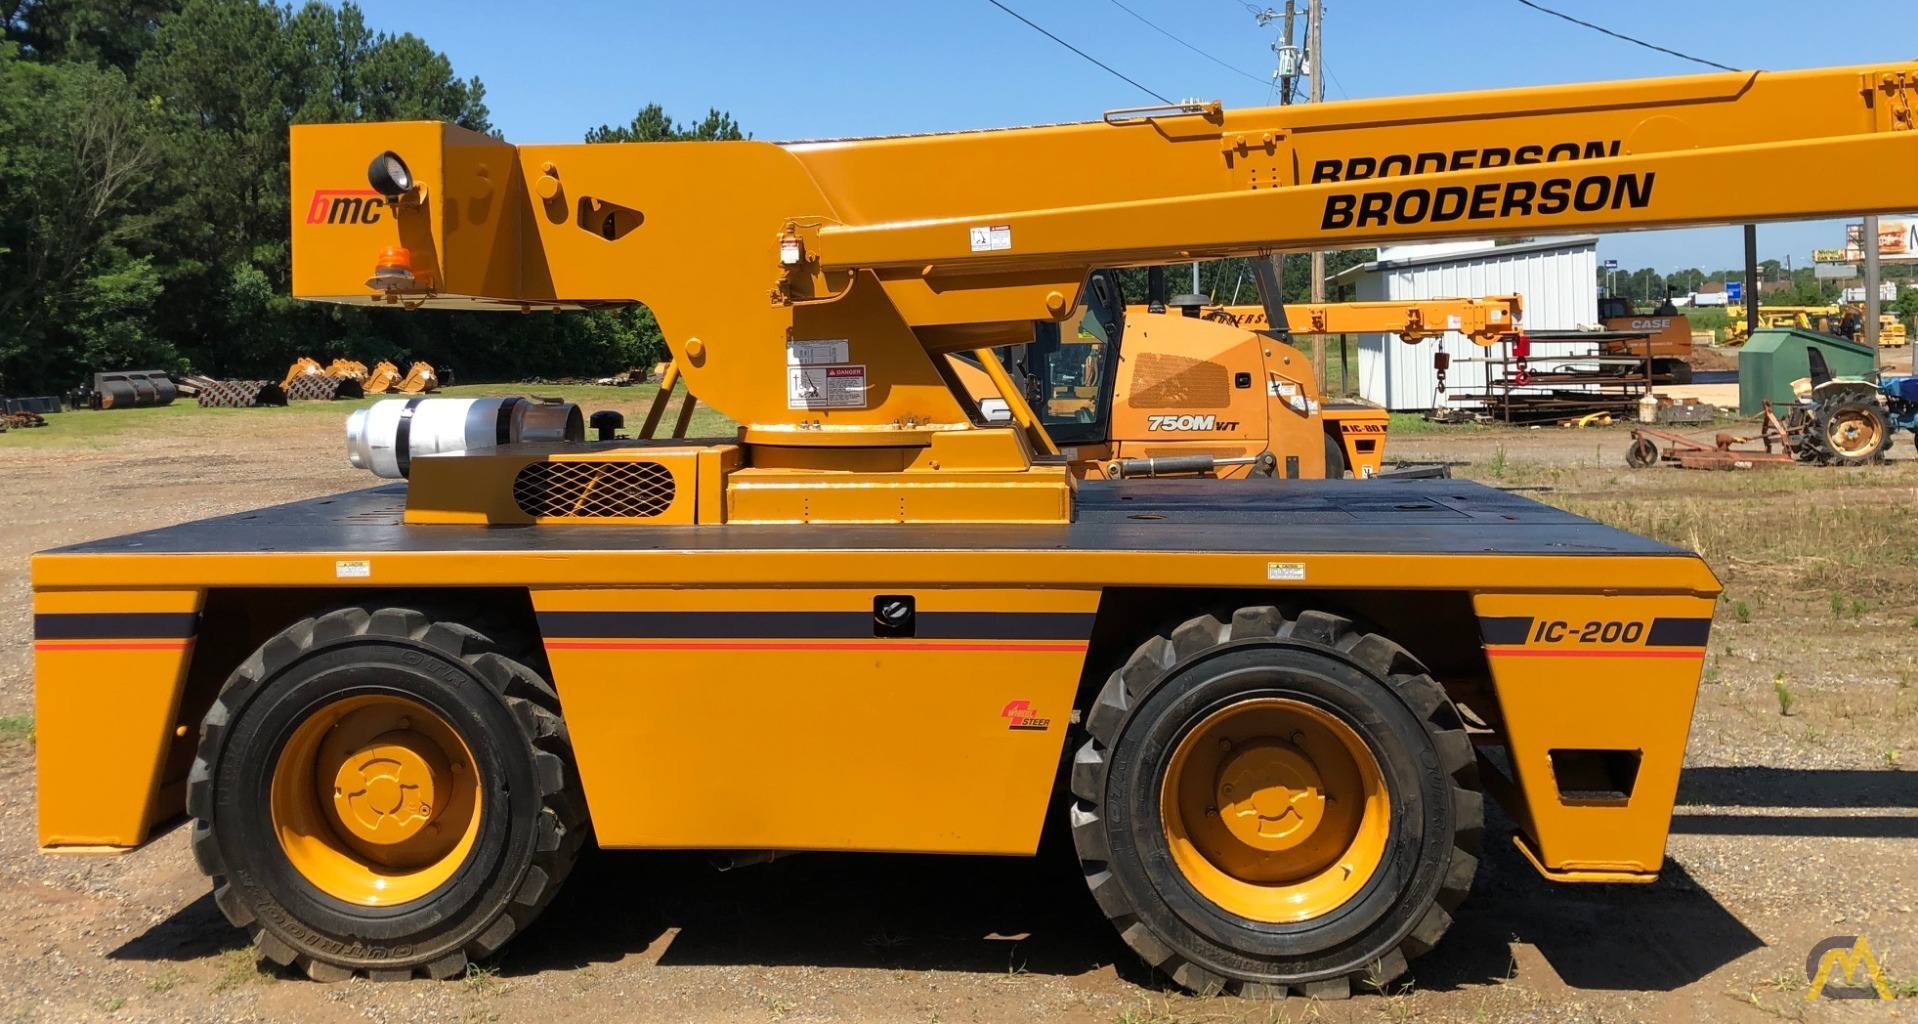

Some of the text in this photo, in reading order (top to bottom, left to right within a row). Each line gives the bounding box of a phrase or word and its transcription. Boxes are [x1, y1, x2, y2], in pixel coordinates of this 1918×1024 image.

[306, 190, 383, 224] bmc
[1320, 171, 1656, 230] BRODERSON
[1631, 319, 1671, 329] CASE
[1148, 415, 1216, 431] 750M
[1533, 621, 1644, 643] IC-200
[1022, 718, 1050, 726] STEER
